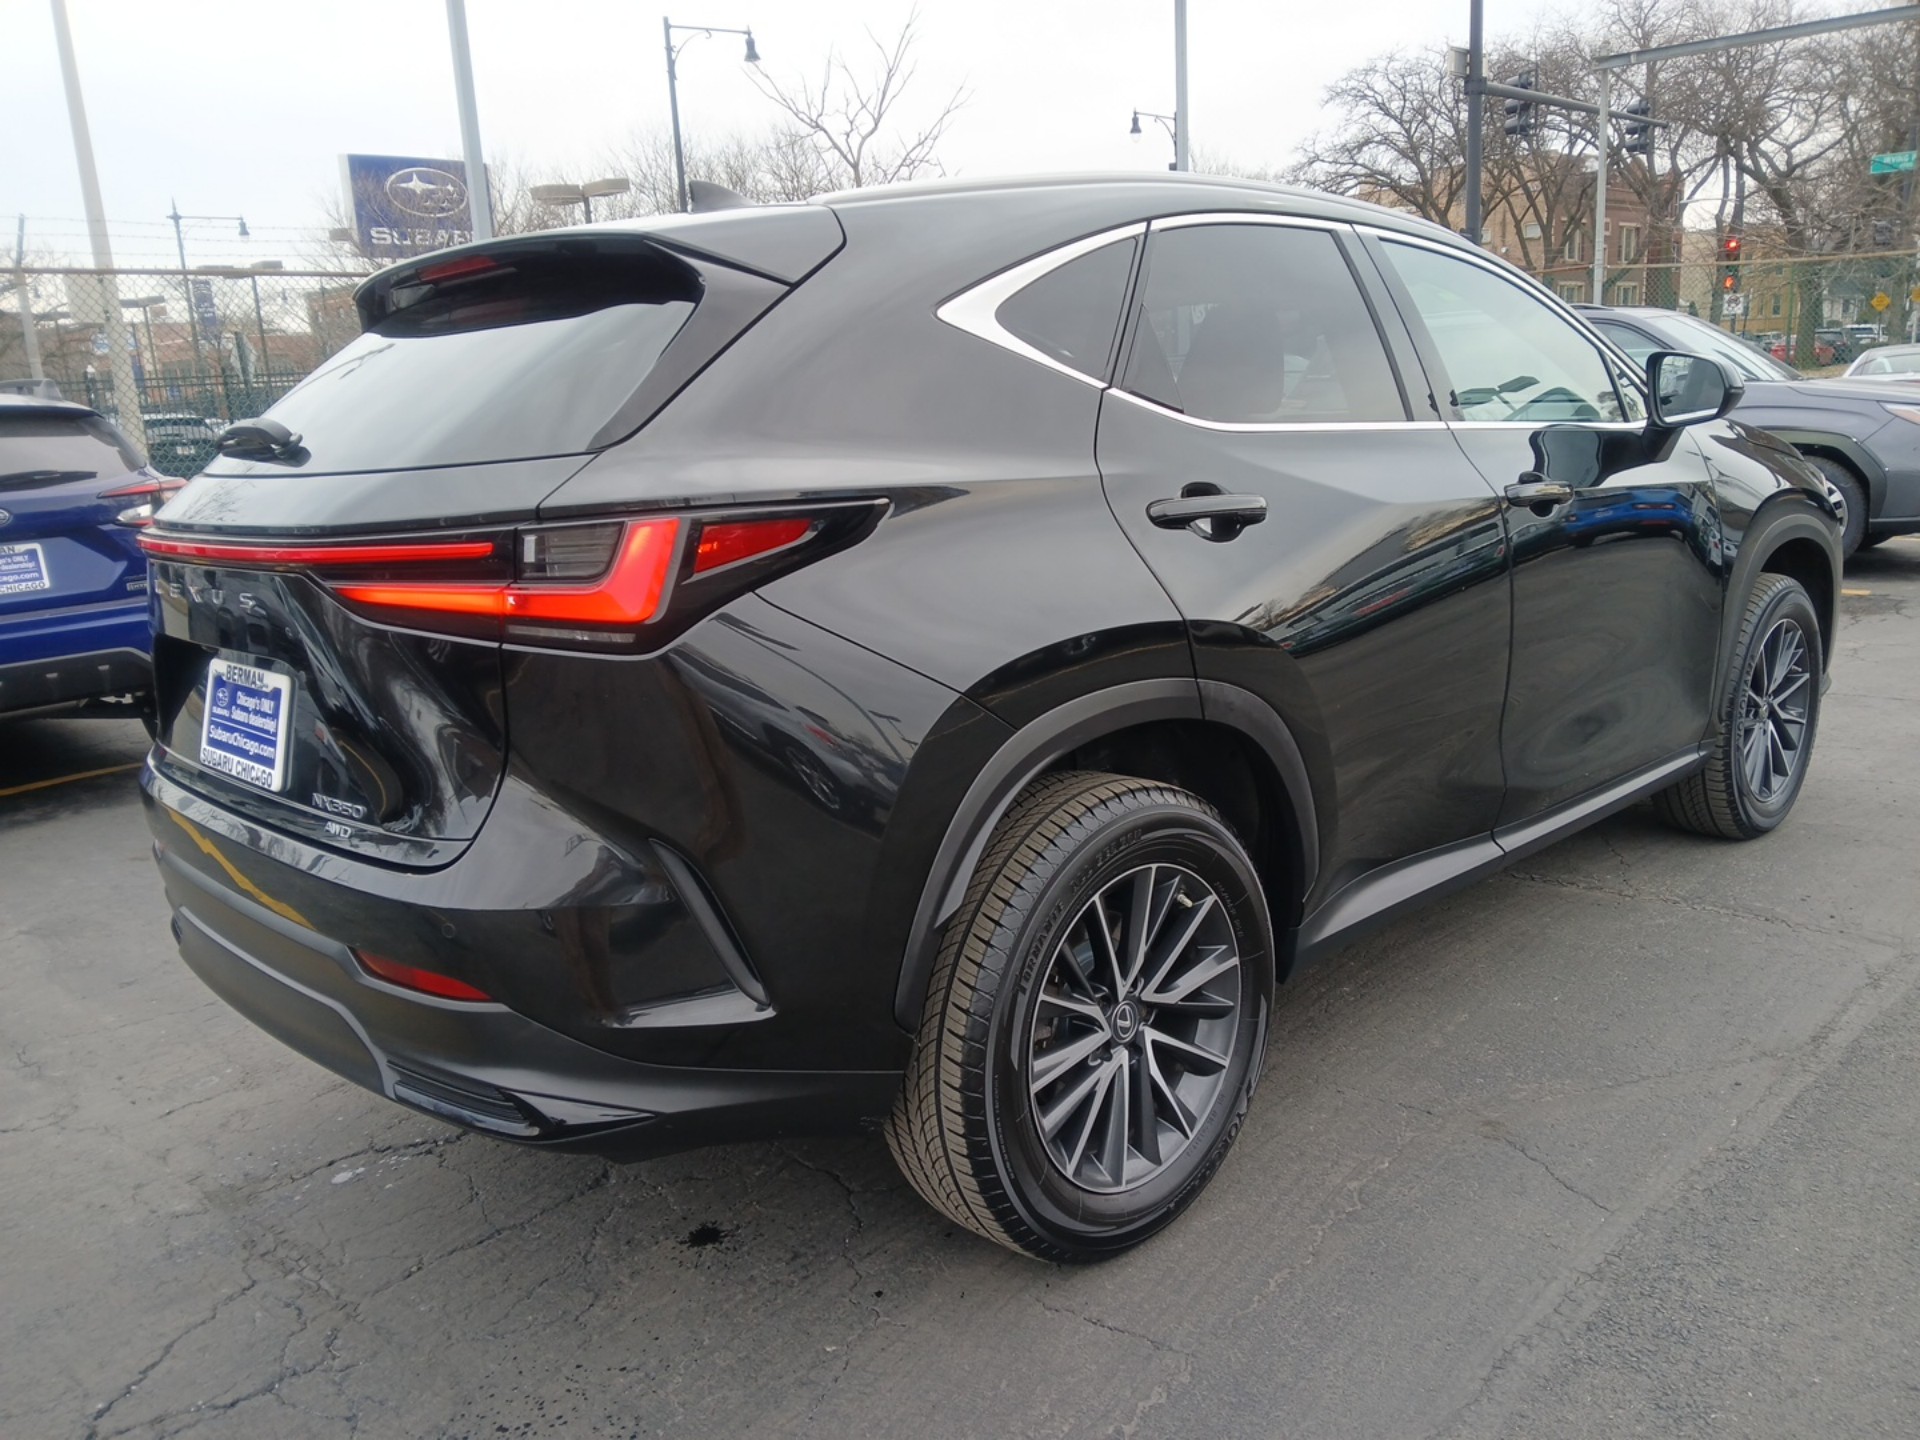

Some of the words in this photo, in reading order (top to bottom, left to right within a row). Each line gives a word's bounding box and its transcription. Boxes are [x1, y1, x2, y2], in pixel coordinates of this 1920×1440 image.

[370, 227, 473, 245] SUBAR
[155, 580, 255, 608] LEXUS
[226, 664, 265, 688] BERMAN
[260, 697, 274, 714] ONLY
[209, 724, 275, 759] SubaruChicago.com
[202, 747, 233, 772] SUBARU
[235, 760, 273, 788] CHICAGO
[312, 792, 367, 819] NX350
[324, 821, 352, 838] AWD
